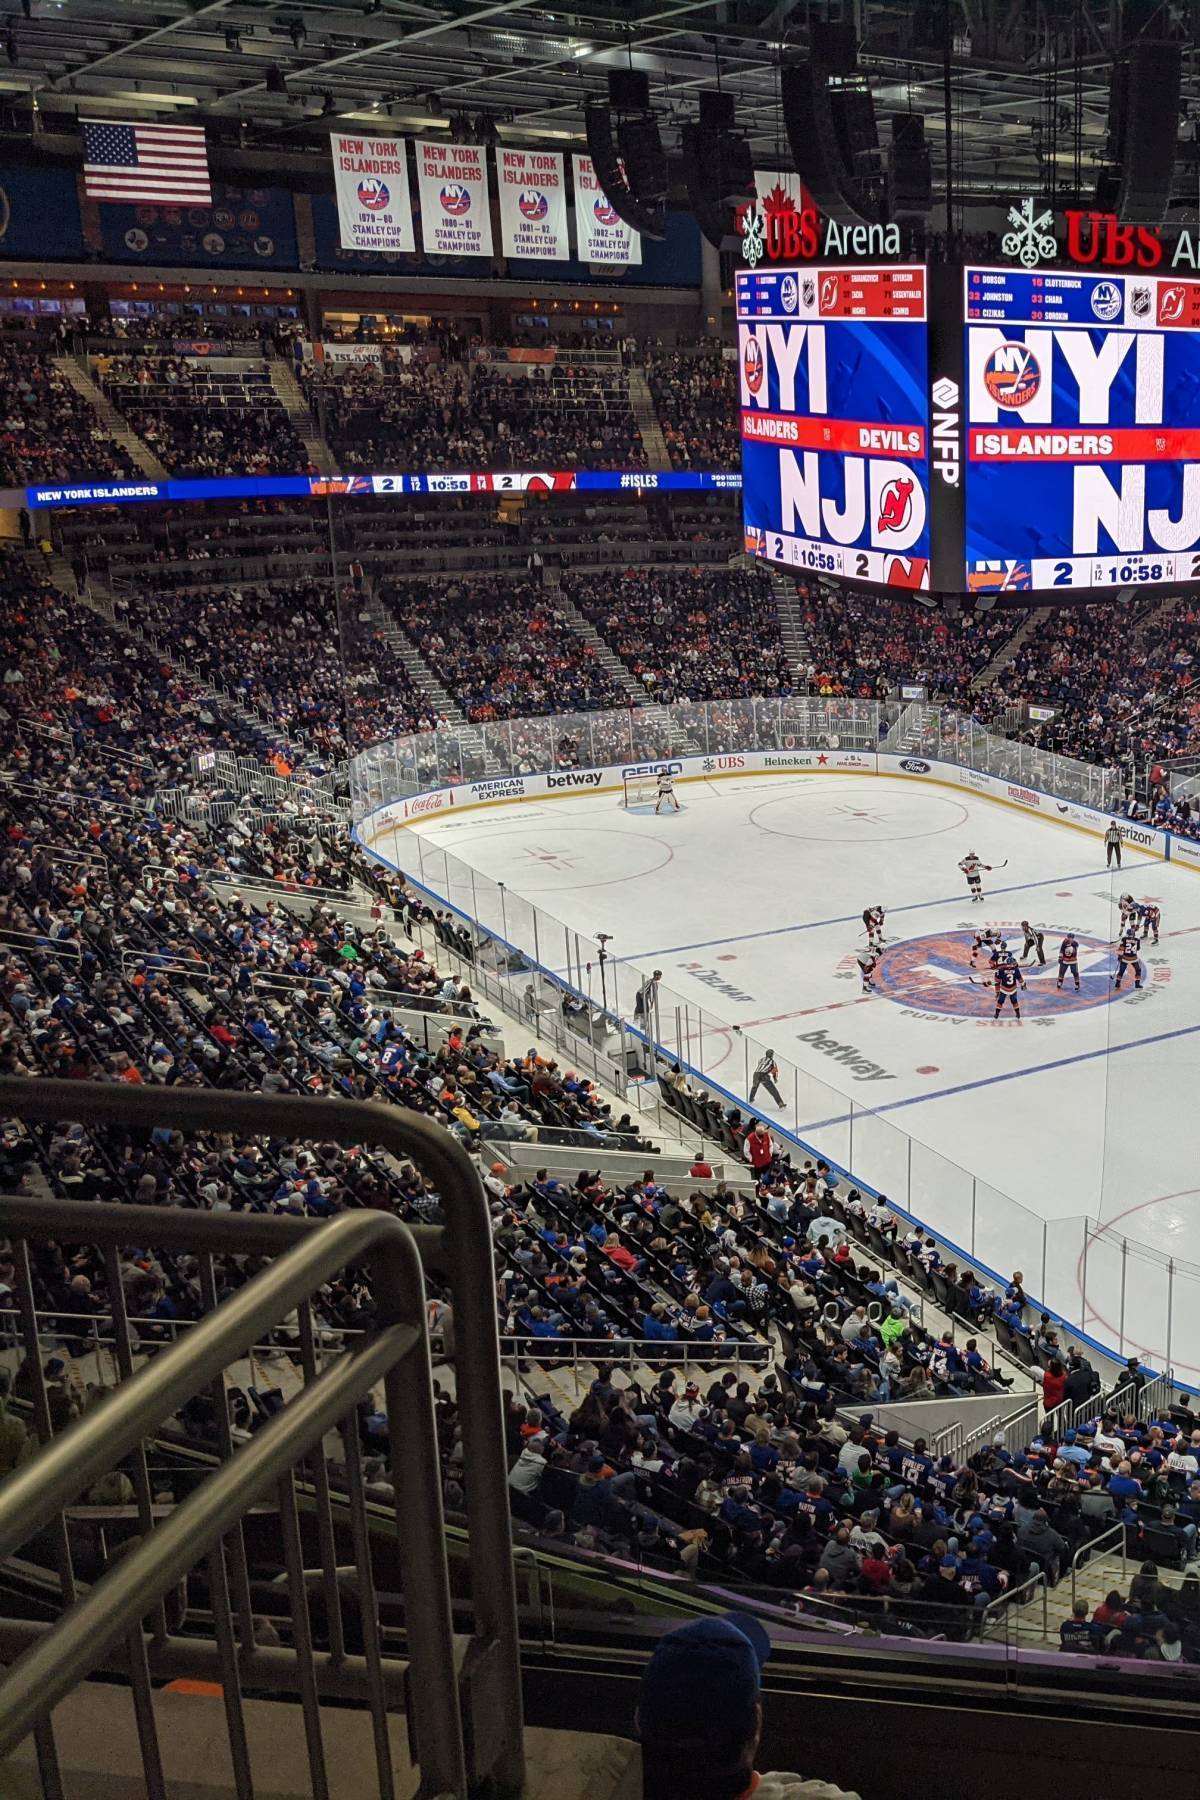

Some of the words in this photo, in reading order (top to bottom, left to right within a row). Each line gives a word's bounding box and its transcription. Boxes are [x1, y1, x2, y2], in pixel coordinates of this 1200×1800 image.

[339, 140, 363, 154] NEW
[369, 142, 398, 156] YORK
[423, 146, 446, 161] NEW
[452, 150, 479, 163] YORK
[340, 158, 401, 174] ISLANDERS
[503, 153, 526, 168] NEW
[531, 155, 557, 169] YORK
[424, 163, 481, 181] ISLANDERS
[504, 171, 558, 186] ISLANDERS
[353, 225, 384, 235] STANLEY
[387, 227, 401, 235] CUP
[435, 230, 465, 240] STANLEY
[467, 232, 481, 240] CUP
[764, 210, 819, 260] UBS
[824, 219, 900, 256] Arena
[356, 237, 400, 247] CHAMPIONS
[438, 241, 480, 251] CHAMPIONS
[514, 235, 544, 244] STANLEY
[544, 236, 557, 244] CUP
[588, 239, 616, 249] STANLEY
[618, 241, 630, 249] CUP
[1065, 210, 1162, 267] UBS
[516, 246, 556, 256] CHAMPIONS
[591, 251, 629, 259] CHAMPIONS
[739, 324, 827, 413] NYI
[968, 327, 1164, 424] NYI
[744, 416, 798, 440] ISLANDERS
[858, 428, 920, 453] DEVILS
[933, 413, 959, 483] NFP
[975, 434, 1113, 456] ISLANDERS
[382, 479, 394, 490] 2
[430, 480, 468, 490] 10:58
[501, 477, 513, 487] 2
[621, 475, 658, 488] #ISLES
[37, 491, 62, 501] NEW
[64, 490, 91, 499] YORK
[93, 487, 157, 499] ISLANDERS
[779, 449, 926, 550] NJD
[775, 537, 784, 559] 2
[801, 550, 835, 570] 10:58
[856, 554, 869, 577] 2
[1054, 562, 1072, 585] 2
[1109, 565, 1162, 583] 10:58
[718, 756, 745, 769] UBS
[764, 757, 812, 766] Heineken
[905, 761, 925, 772] Ford
[471, 779, 523, 793] AMERICAN
[546, 772, 602, 788] betway
[479, 787, 525, 800] EXPRESS
[1117, 825, 1151, 846] erizon
[1126, 941, 1139, 954] 24
[1007, 973, 1014, 985] 3
[796, 1029, 898, 1082] betway
